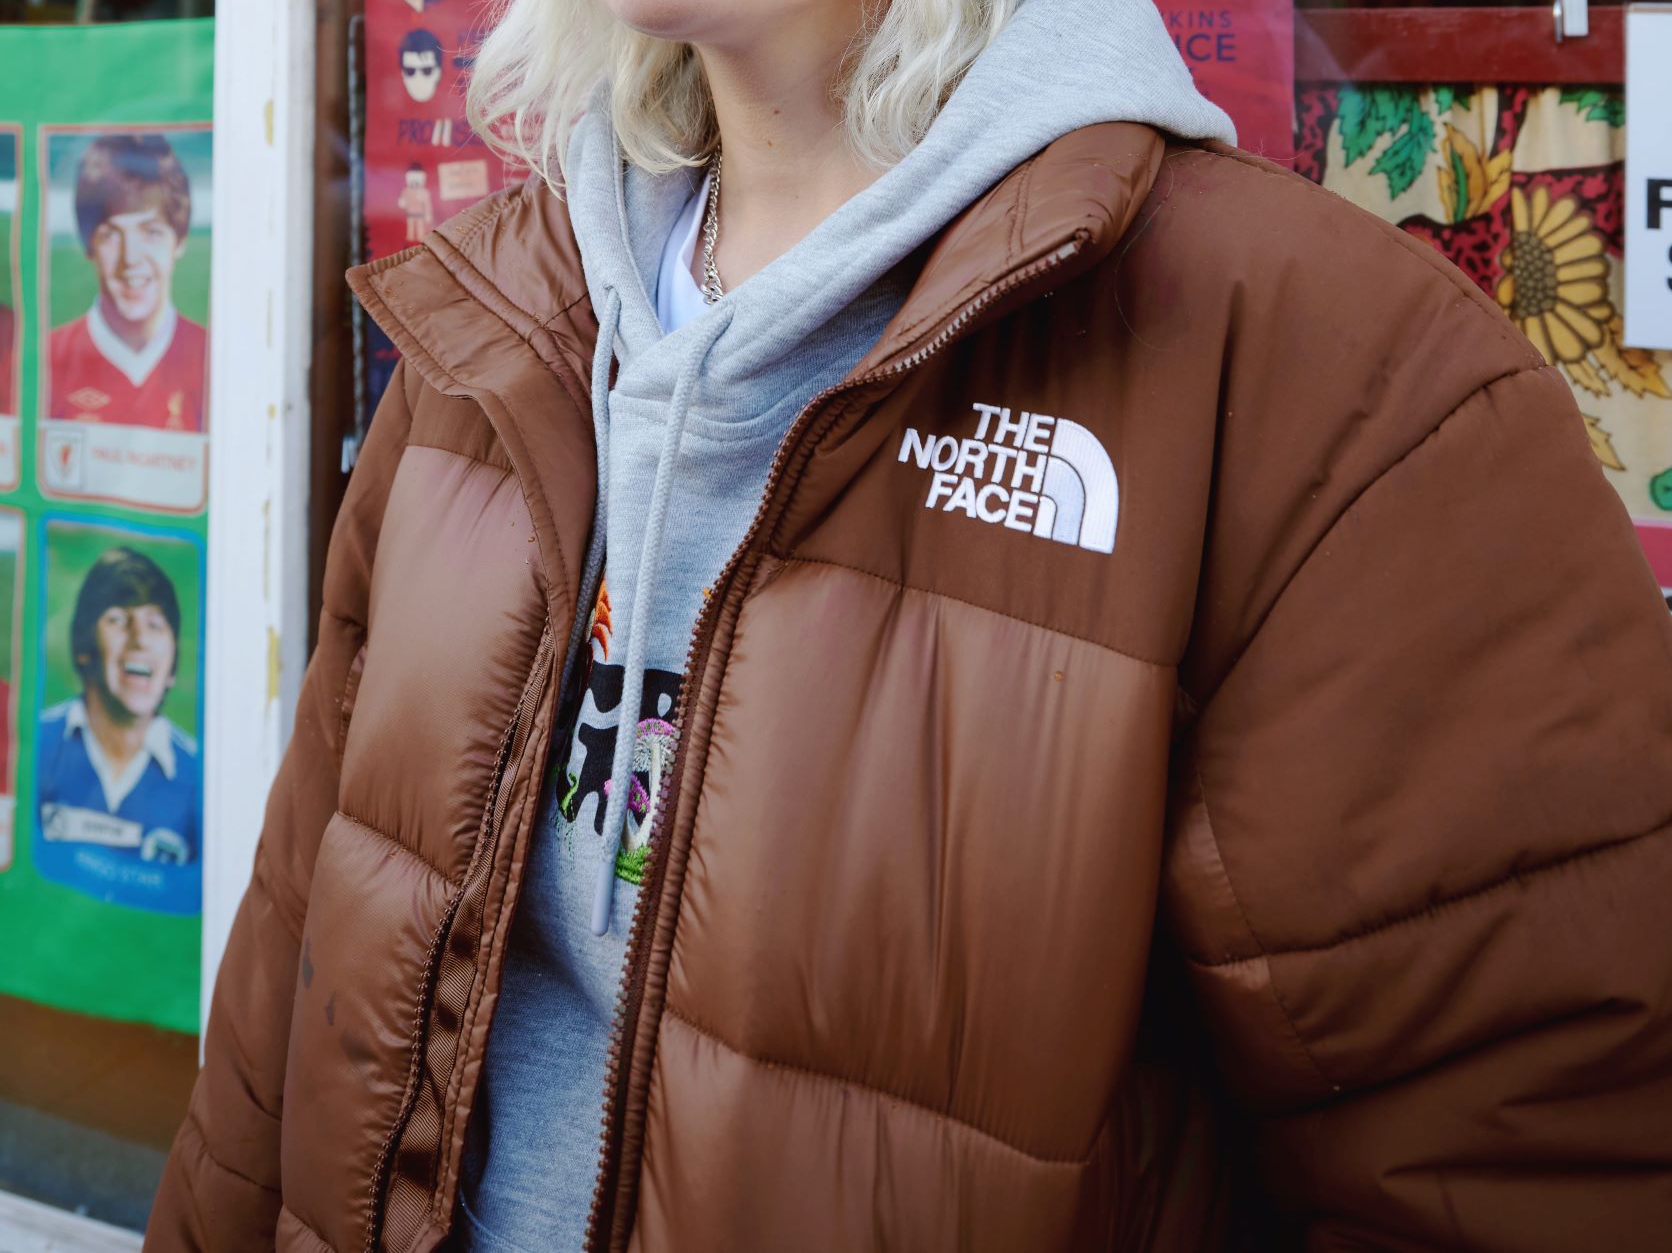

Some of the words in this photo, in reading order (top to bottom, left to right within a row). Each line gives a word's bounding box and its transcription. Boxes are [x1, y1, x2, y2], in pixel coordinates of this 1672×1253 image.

[1160, 9, 1233, 29] KINS
[972, 402, 1055, 454] THE
[897, 428, 1049, 494] NORTH
[924, 471, 1040, 533] FACE
